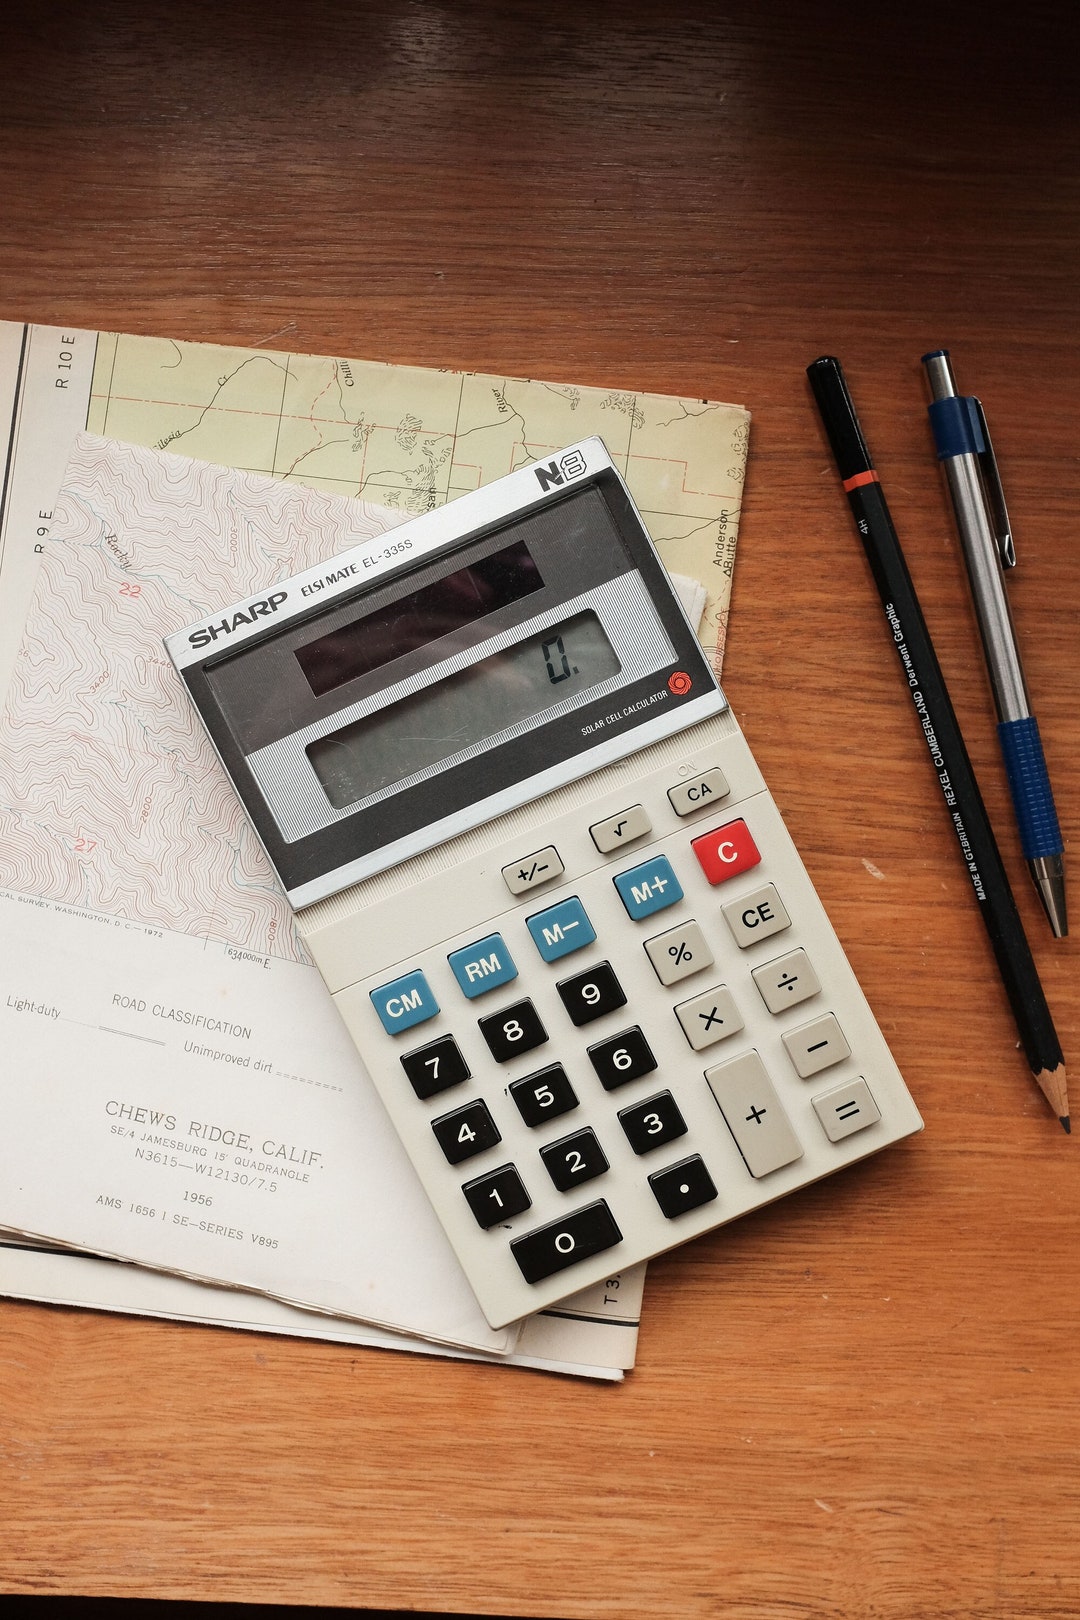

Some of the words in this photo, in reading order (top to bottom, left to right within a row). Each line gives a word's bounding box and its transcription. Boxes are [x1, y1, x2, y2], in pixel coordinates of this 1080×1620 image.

[61, 335, 75, 345] E
[57, 351, 73, 371] 10
[339, 360, 355, 387] Chilli
[55, 378, 69, 389] R
[491, 387, 508, 413] River
[39, 510, 52, 520] E
[34, 543, 45, 554] R
[229, 526, 238, 553] 3000
[713, 508, 729, 567] Anderson
[104, 534, 131, 570] Rocky
[362, 539, 413, 568] EL-335S
[724, 535, 737, 570] Butte
[118, 582, 142, 599] 22
[188, 591, 288, 650] SHARP
[885, 602, 904, 642] Graphic
[897, 643, 918, 687] Derwent
[89, 670, 110, 694] 3400
[581, 719, 606, 736] SOLAR
[605, 711, 624, 725] CELL
[622, 689, 669, 717] CALCULATOR
[913, 691, 945, 768] CUMBERLAND
[687, 783, 712, 801] CA
[937, 769, 957, 807] REXEL
[140, 796, 152, 823] 2800
[74, 838, 97, 853] 27
[717, 841, 738, 863] C
[968, 862, 978, 872] IN
[630, 875, 668, 905] M+
[971, 873, 987, 901] MADE
[741, 901, 775, 929] CE
[668, 942, 693, 965] %
[464, 952, 502, 983] RM
[385, 988, 423, 1018] CM
[581, 983, 601, 1005] 9
[6, 995, 61, 1021] Light-duty
[112, 993, 147, 1013] ROAD
[152, 1004, 252, 1040] CLASSIFICATION
[502, 1019, 524, 1042] 8
[183, 1040, 251, 1068] Unimproved
[253, 1059, 273, 1074] dirt
[424, 1056, 441, 1080] 7
[612, 1048, 633, 1070] 6
[533, 1085, 555, 1107] 5
[105, 1100, 177, 1131] CHEWS
[187, 1120, 254, 1154] RIDGE,
[261, 1139, 325, 1170] CALIF.
[457, 1123, 476, 1144] 4
[643, 1113, 664, 1135] 3
[110, 1124, 135, 1139] SE/4
[140, 1132, 208, 1158] JAMESBURG
[234, 1156, 311, 1184] QUADRANGLE
[565, 1150, 587, 1173] 2
[182, 1190, 214, 1207] 1956
[489, 1188, 505, 1208] 1
[95, 1194, 123, 1210] AMS
[130, 1203, 156, 1219] 1656
[251, 1233, 280, 1250] V895
[554, 1232, 576, 1254] 0
[603, 1294, 618, 1305] T
